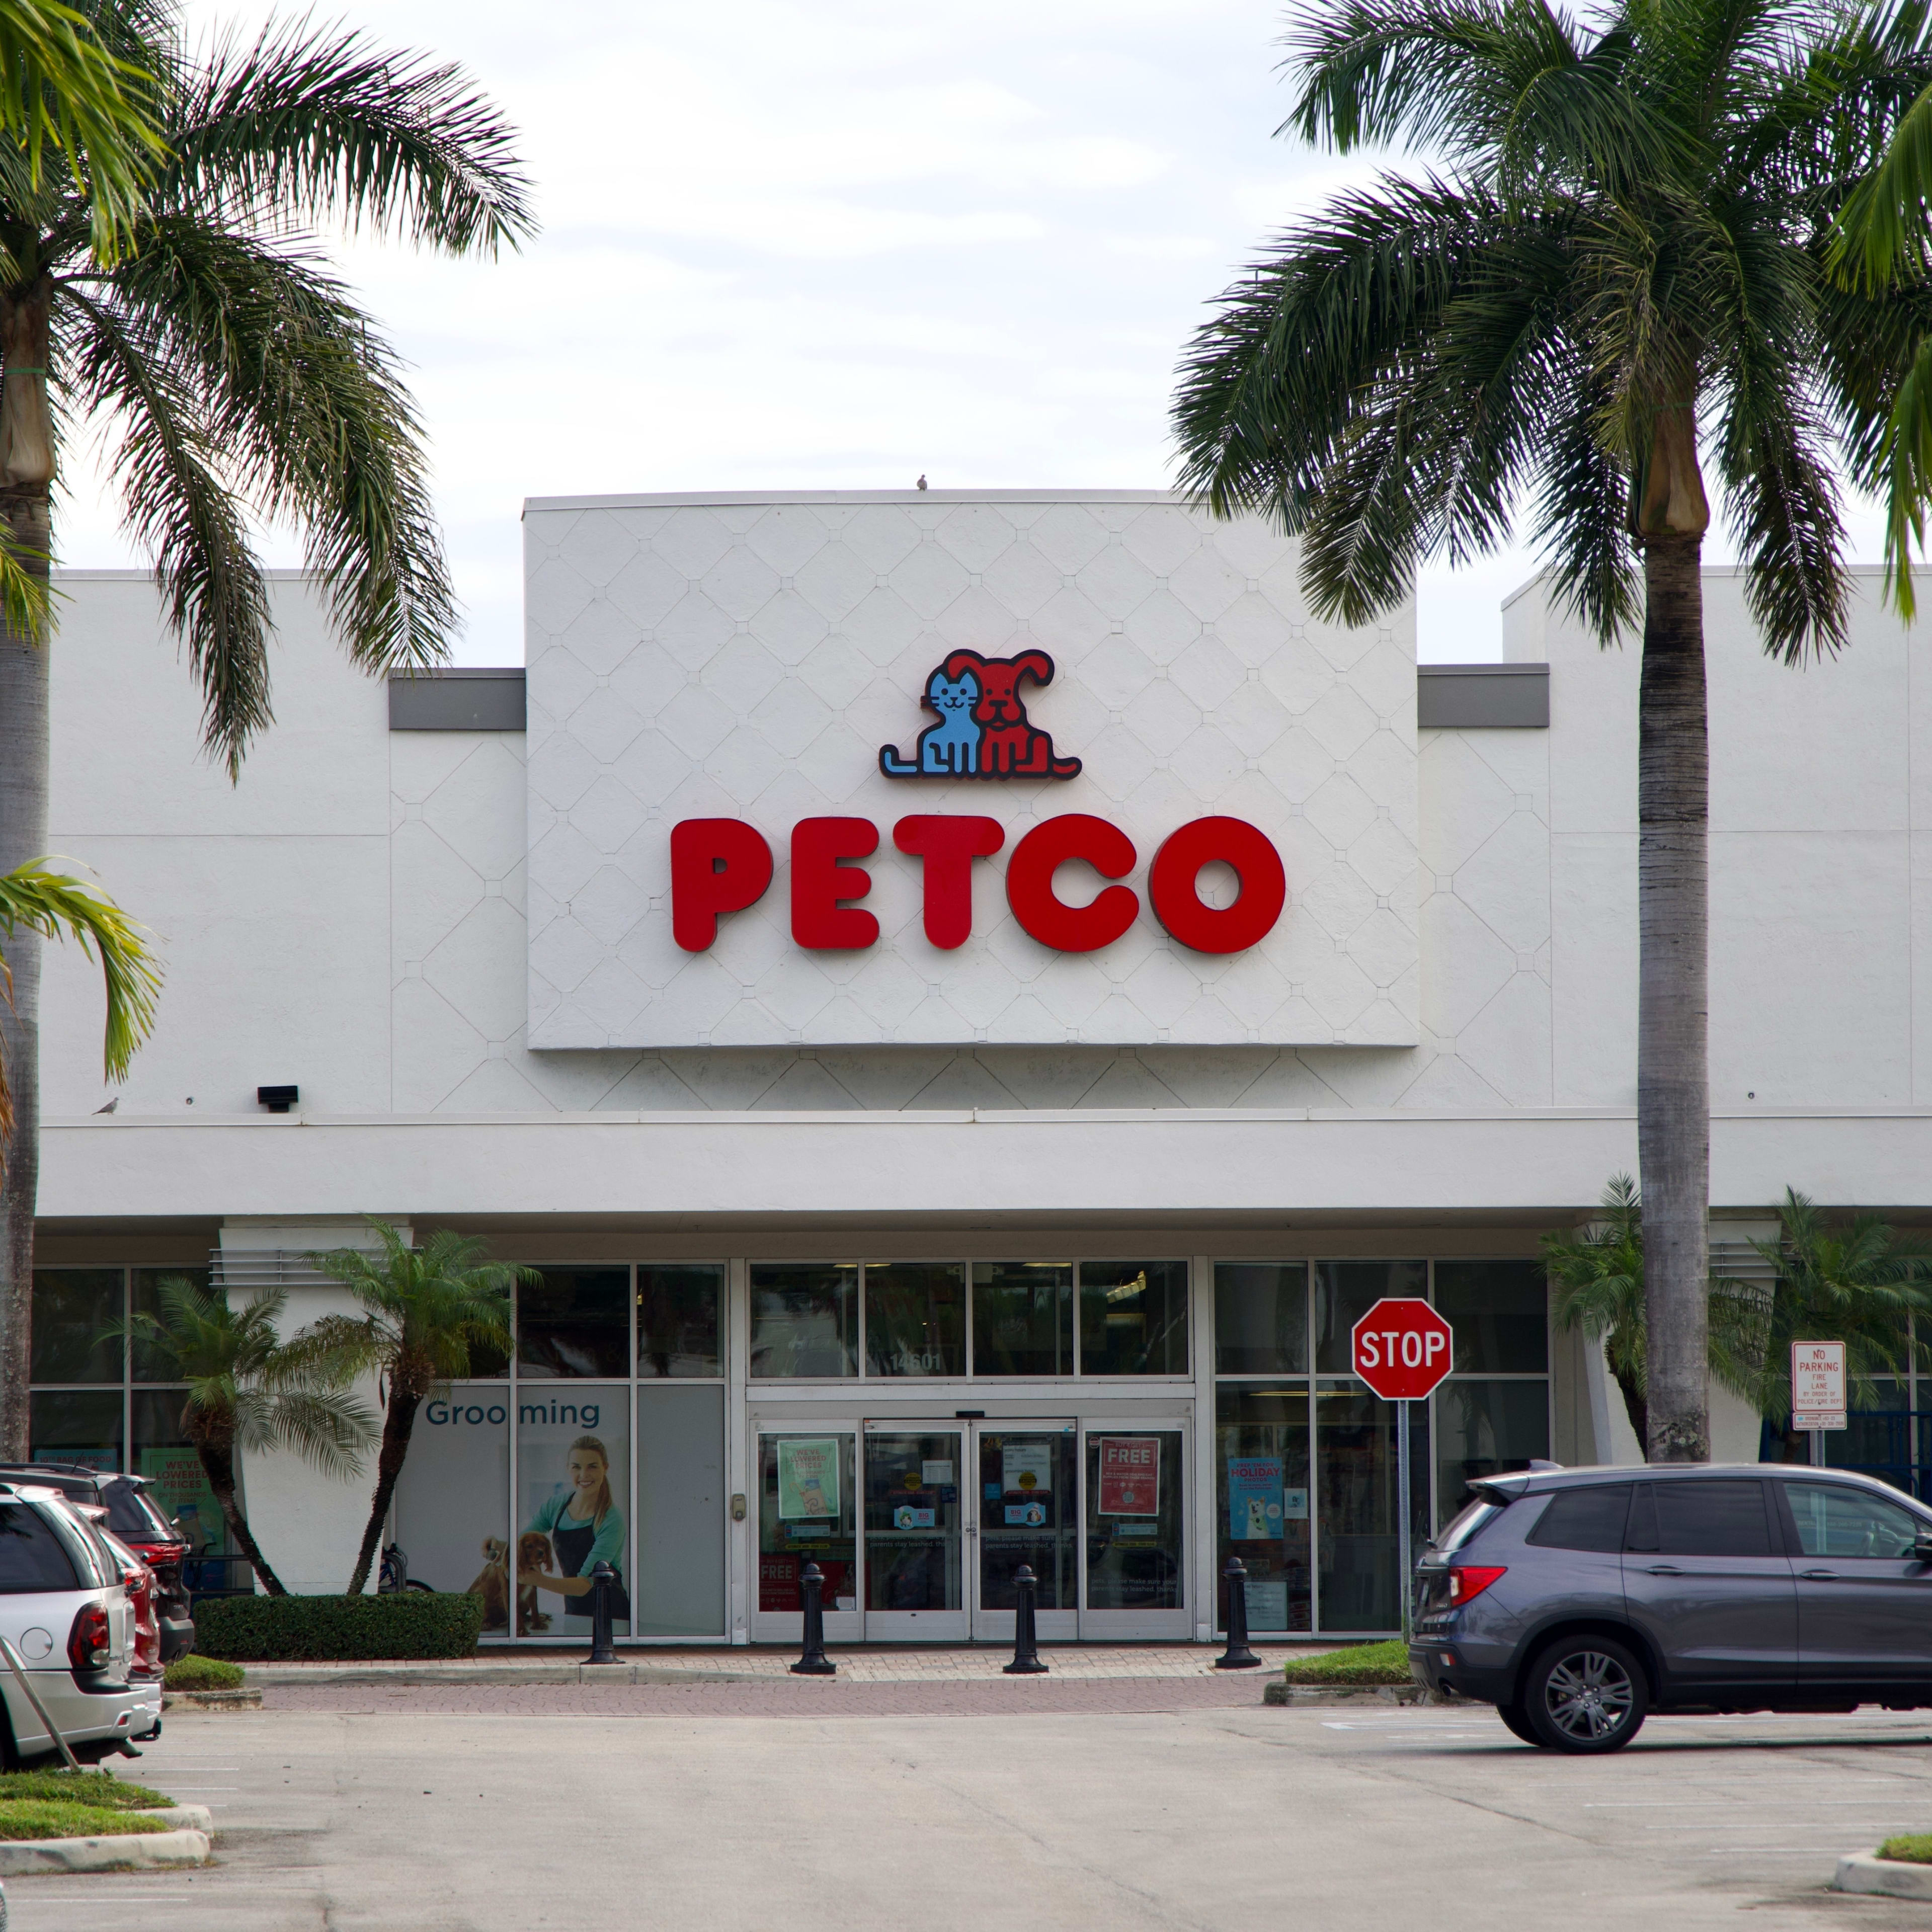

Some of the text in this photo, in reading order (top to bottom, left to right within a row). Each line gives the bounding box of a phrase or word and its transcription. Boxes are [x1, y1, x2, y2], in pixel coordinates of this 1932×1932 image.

[671, 814, 1286, 954] PETCO
[1360, 1331, 1445, 1367] STOP
[1813, 1350, 1825, 1359] NO
[890, 1353, 940, 1372] 14601
[1800, 1362, 1838, 1372] PARKING
[426, 1399, 599, 1429] Grooming
[1108, 1448, 1151, 1464] FREE
[166, 1460, 200, 1469] WE'VE
[156, 1470, 208, 1480] LOWERED
[1231, 1467, 1280, 1477] HOLIDAY
[163, 1481, 202, 1489] PRICES
[761, 1565, 793, 1580] FREE
